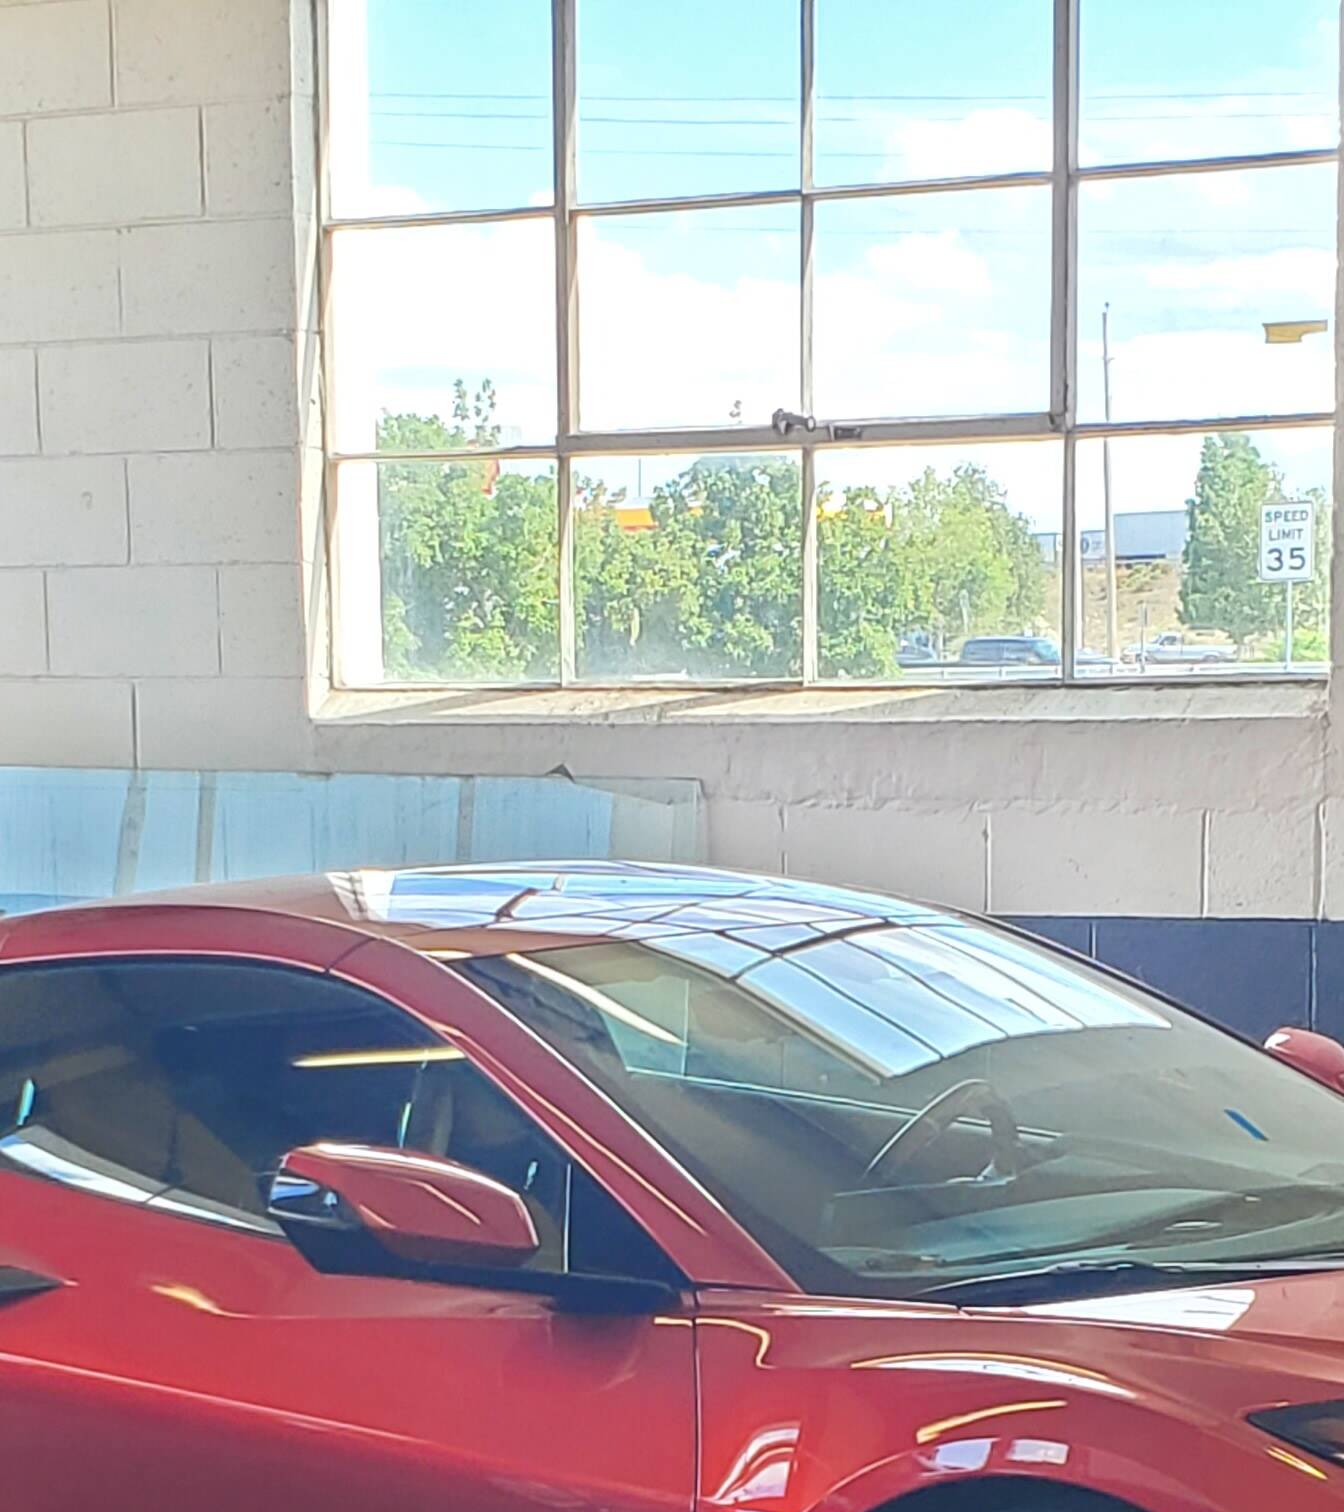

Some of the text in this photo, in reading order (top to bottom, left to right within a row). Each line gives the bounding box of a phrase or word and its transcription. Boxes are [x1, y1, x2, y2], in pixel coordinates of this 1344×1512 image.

[1264, 510, 1309, 523] SPEED
[1268, 528, 1304, 541] LIMIT
[1265, 546, 1307, 572] 35
